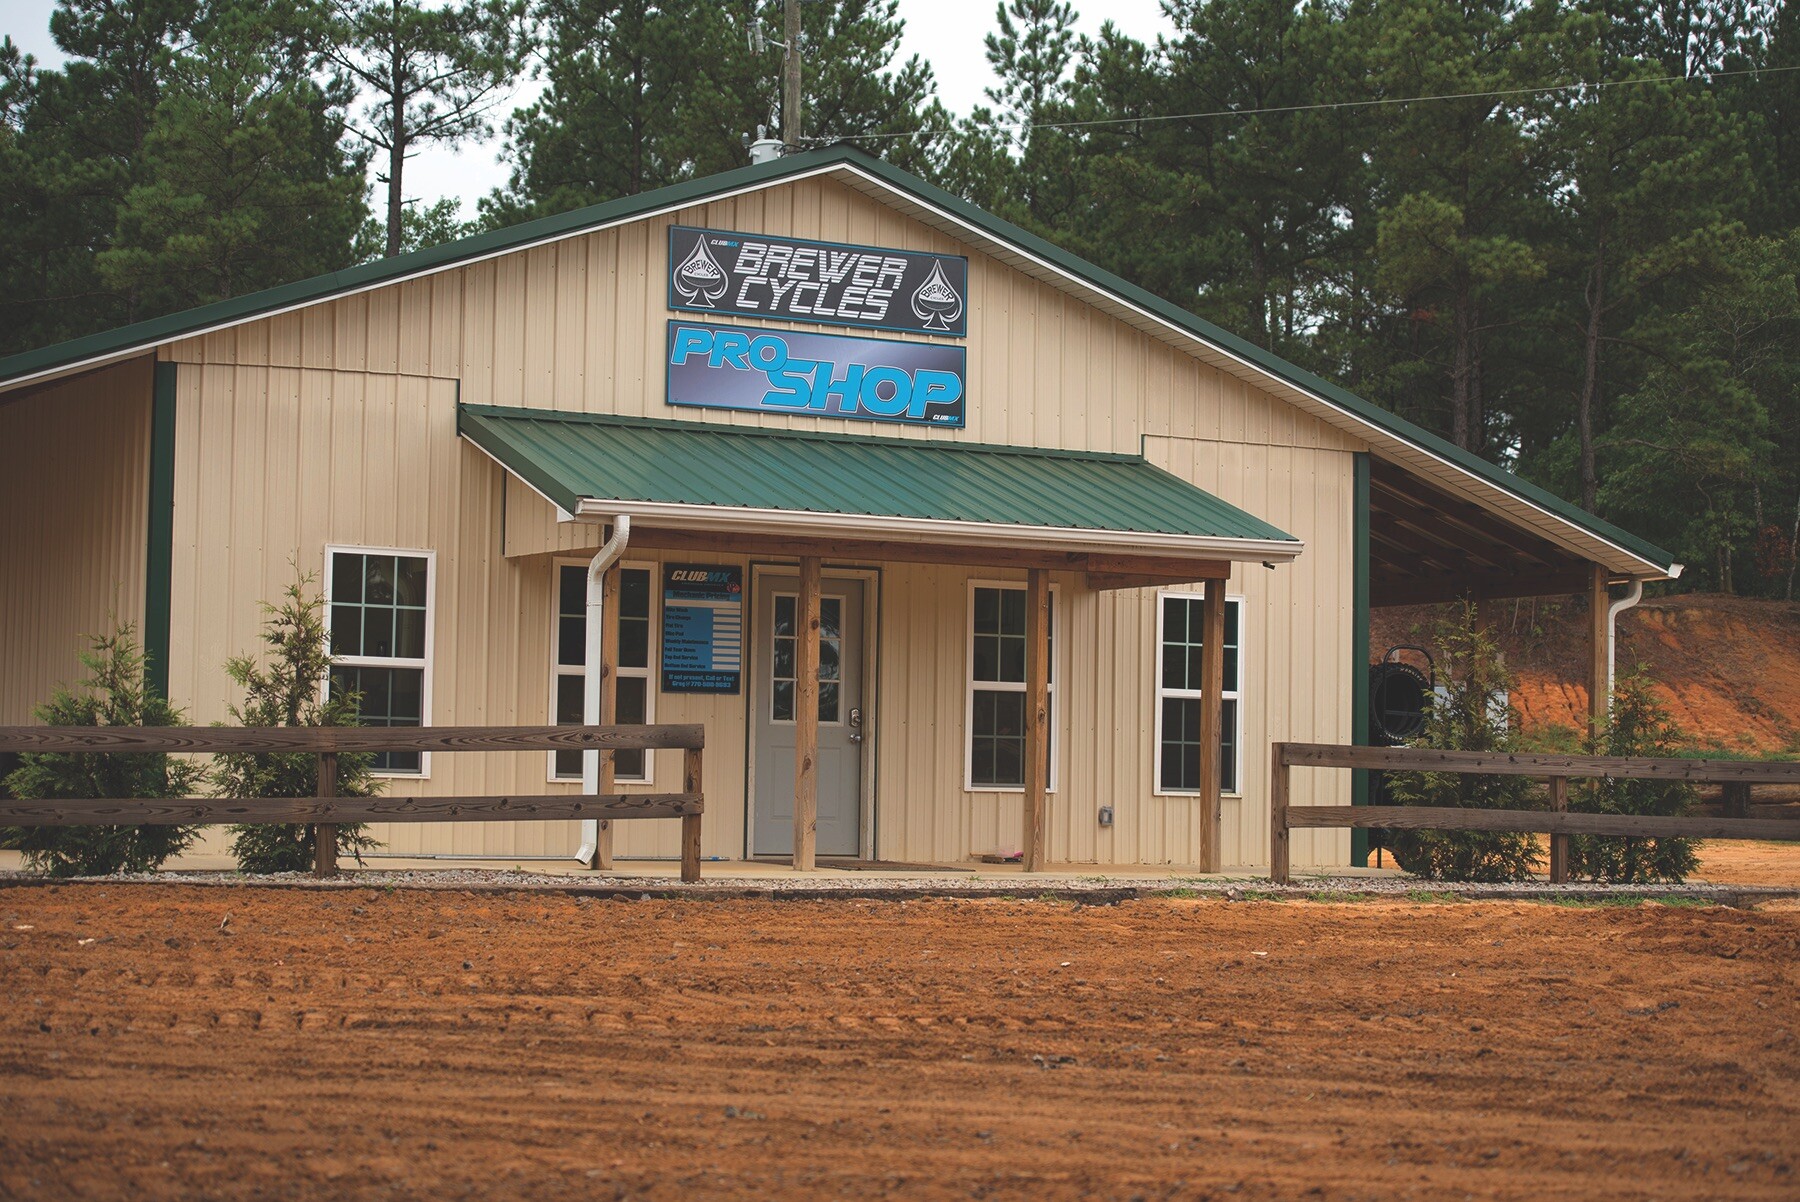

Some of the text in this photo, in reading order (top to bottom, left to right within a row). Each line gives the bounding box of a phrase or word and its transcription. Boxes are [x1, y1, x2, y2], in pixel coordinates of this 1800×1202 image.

[711, 239, 739, 248] CLUBMX
[684, 260, 720, 277] BREWER
[733, 242, 908, 289] BREWER
[736, 276, 894, 320] CYCLES
[921, 284, 954, 301] BREWER
[671, 327, 789, 372] PRO
[761, 358, 962, 417] SHOP
[671, 570, 731, 582] CLUBMX
